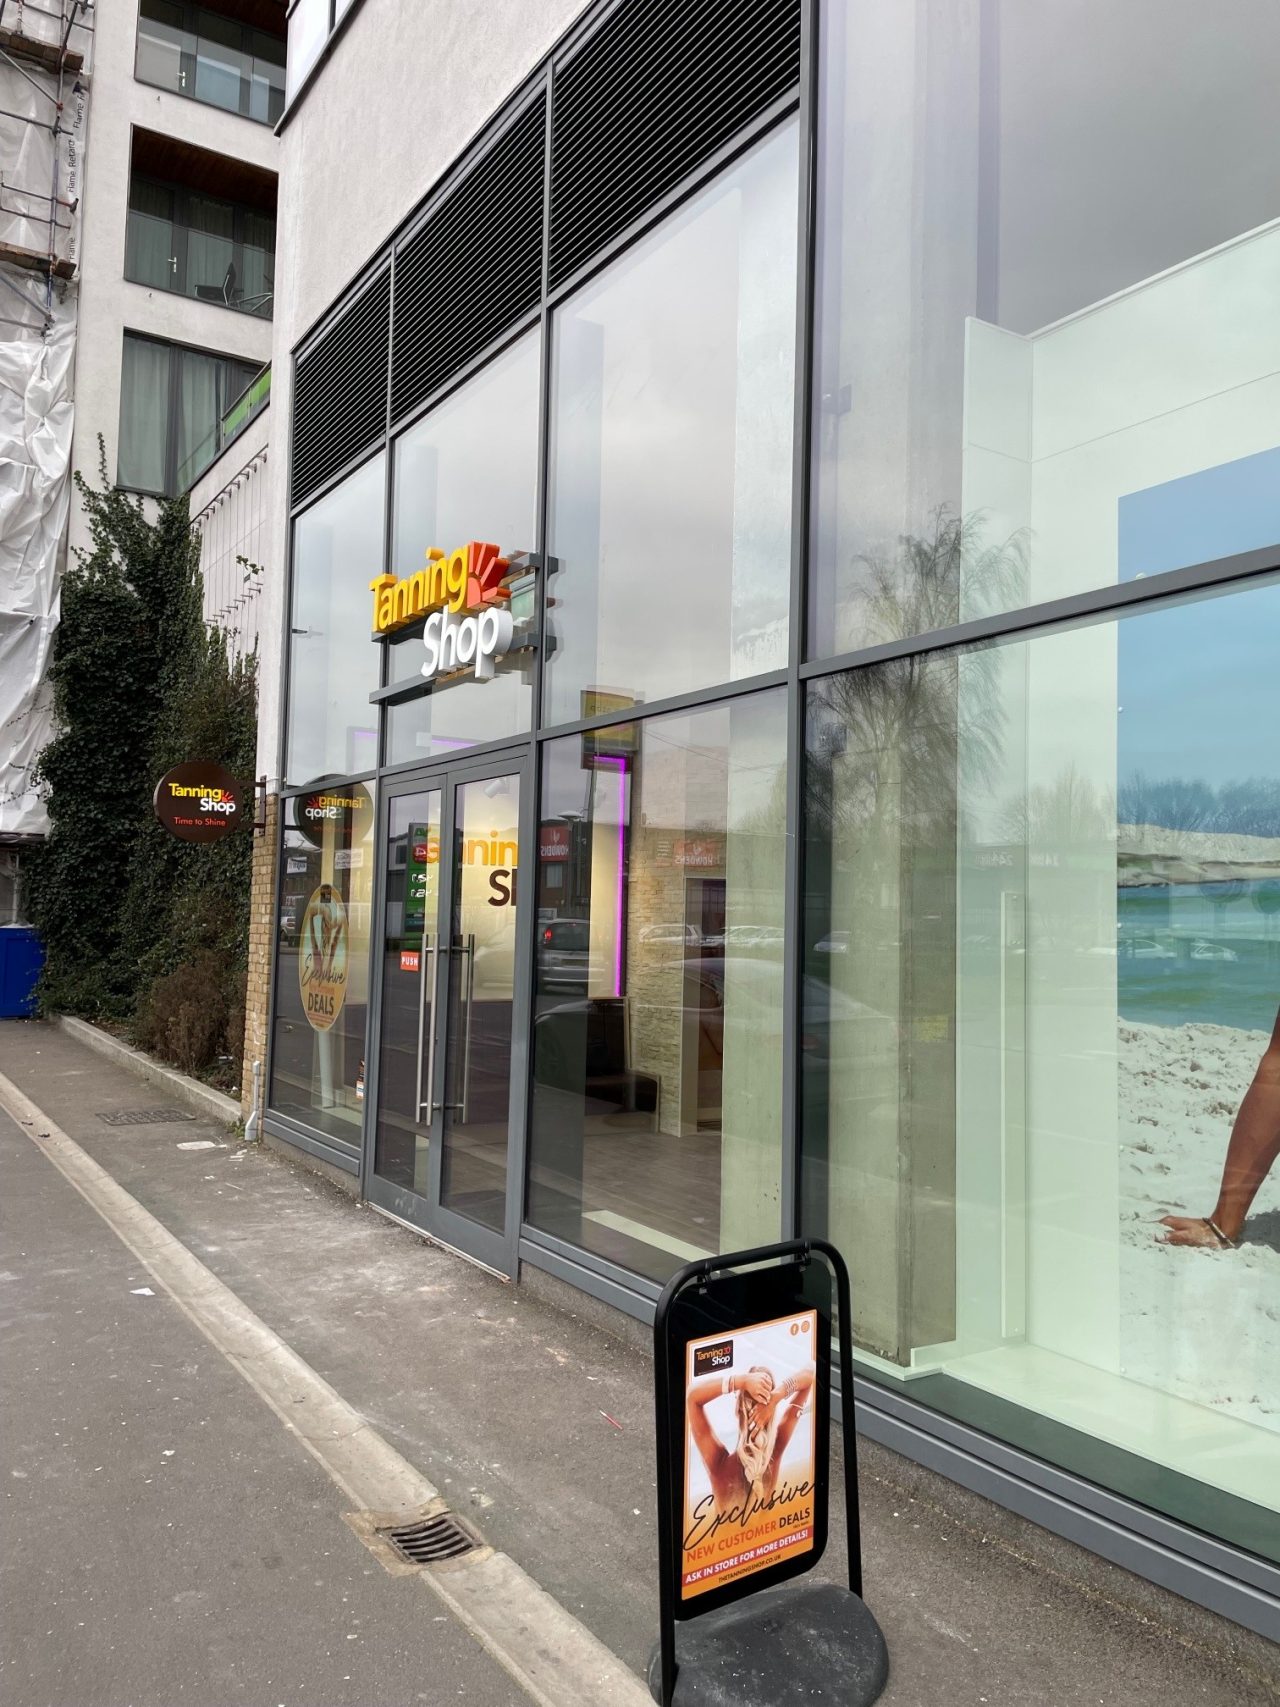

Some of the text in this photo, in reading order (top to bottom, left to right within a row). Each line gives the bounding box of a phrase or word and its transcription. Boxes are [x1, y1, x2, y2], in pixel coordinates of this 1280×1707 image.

[369, 544, 470, 633] Tanning
[420, 604, 511, 679] Shop
[168, 783, 222, 802] Tanning
[200, 796, 236, 816] Shop
[173, 816, 226, 827] Time to Shine
[401, 956, 419, 967] PUSH
[307, 992, 335, 1017] DEALS
[696, 1347, 724, 1361] Tanning
[711, 1355, 731, 1367] Shop
[683, 1479, 814, 1551] Exclusive
[687, 1542, 715, 1562] NEW
[718, 1520, 777, 1551] CUSTOMER
[778, 1507, 811, 1529] DEALS
[685, 1528, 808, 1584] ASK IN STORE FOR MORE DETAILS!
